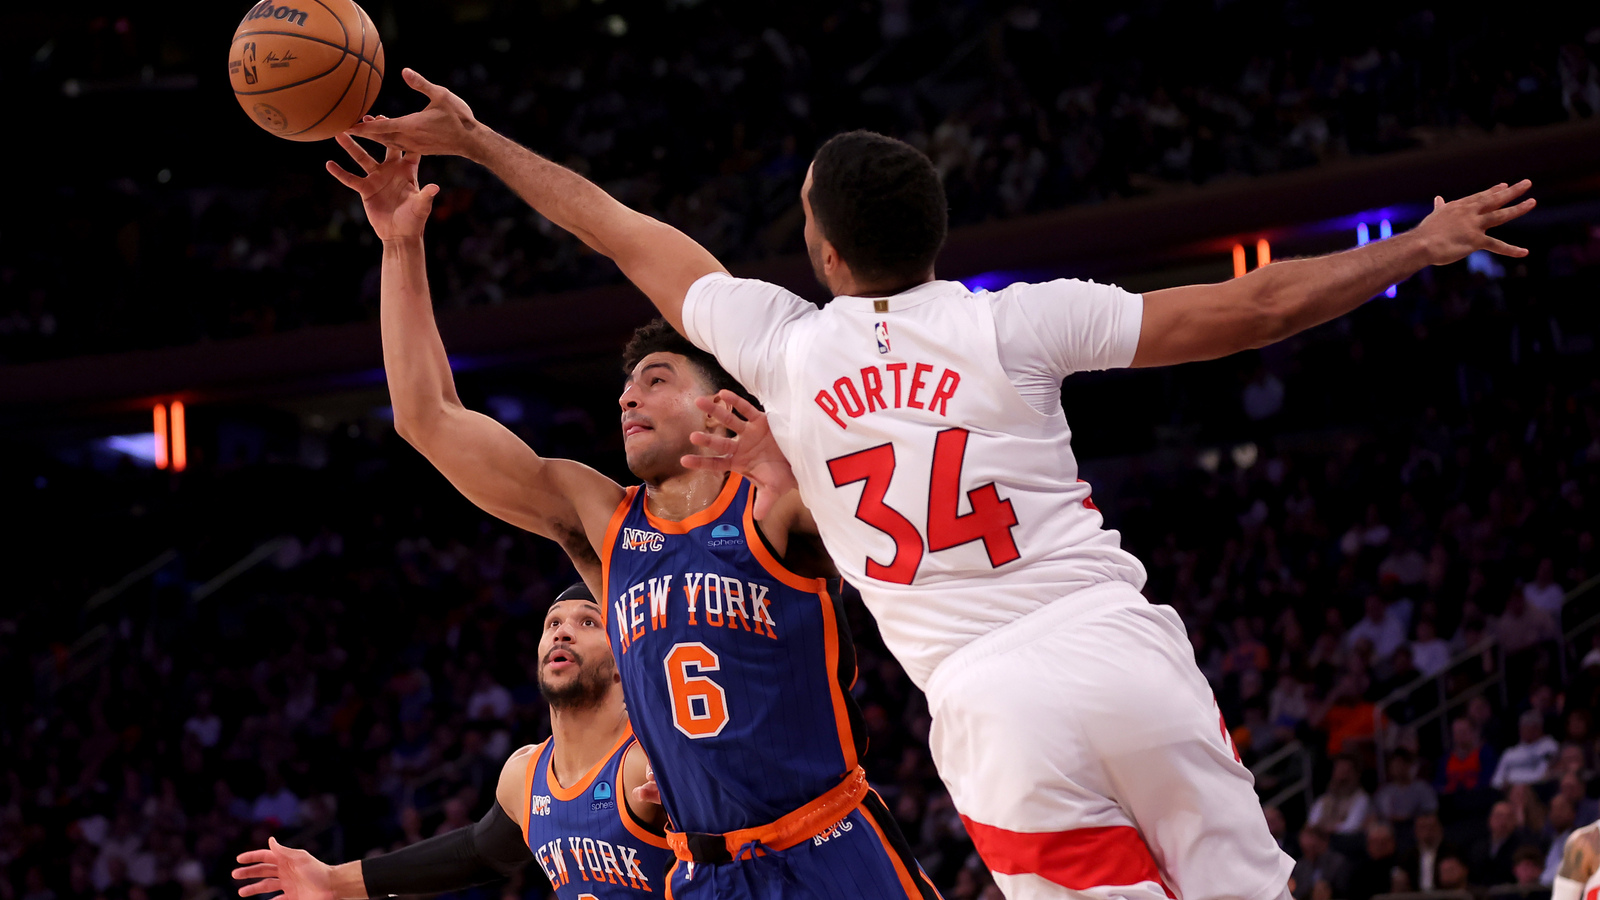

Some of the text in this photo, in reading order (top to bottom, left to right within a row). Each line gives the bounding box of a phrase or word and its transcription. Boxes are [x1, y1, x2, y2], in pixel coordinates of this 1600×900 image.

[241, 0, 309, 27] ilson
[814, 362, 961, 430] PORTER
[826, 427, 1021, 585] 34
[622, 528, 665, 552] NYC
[707, 537, 744, 547] sphere
[614, 573, 778, 654] NEW YORK
[663, 641, 730, 740] 6
[532, 795, 551, 816] NYC
[591, 801, 614, 812] sphere
[568, 836, 653, 892] YORK
